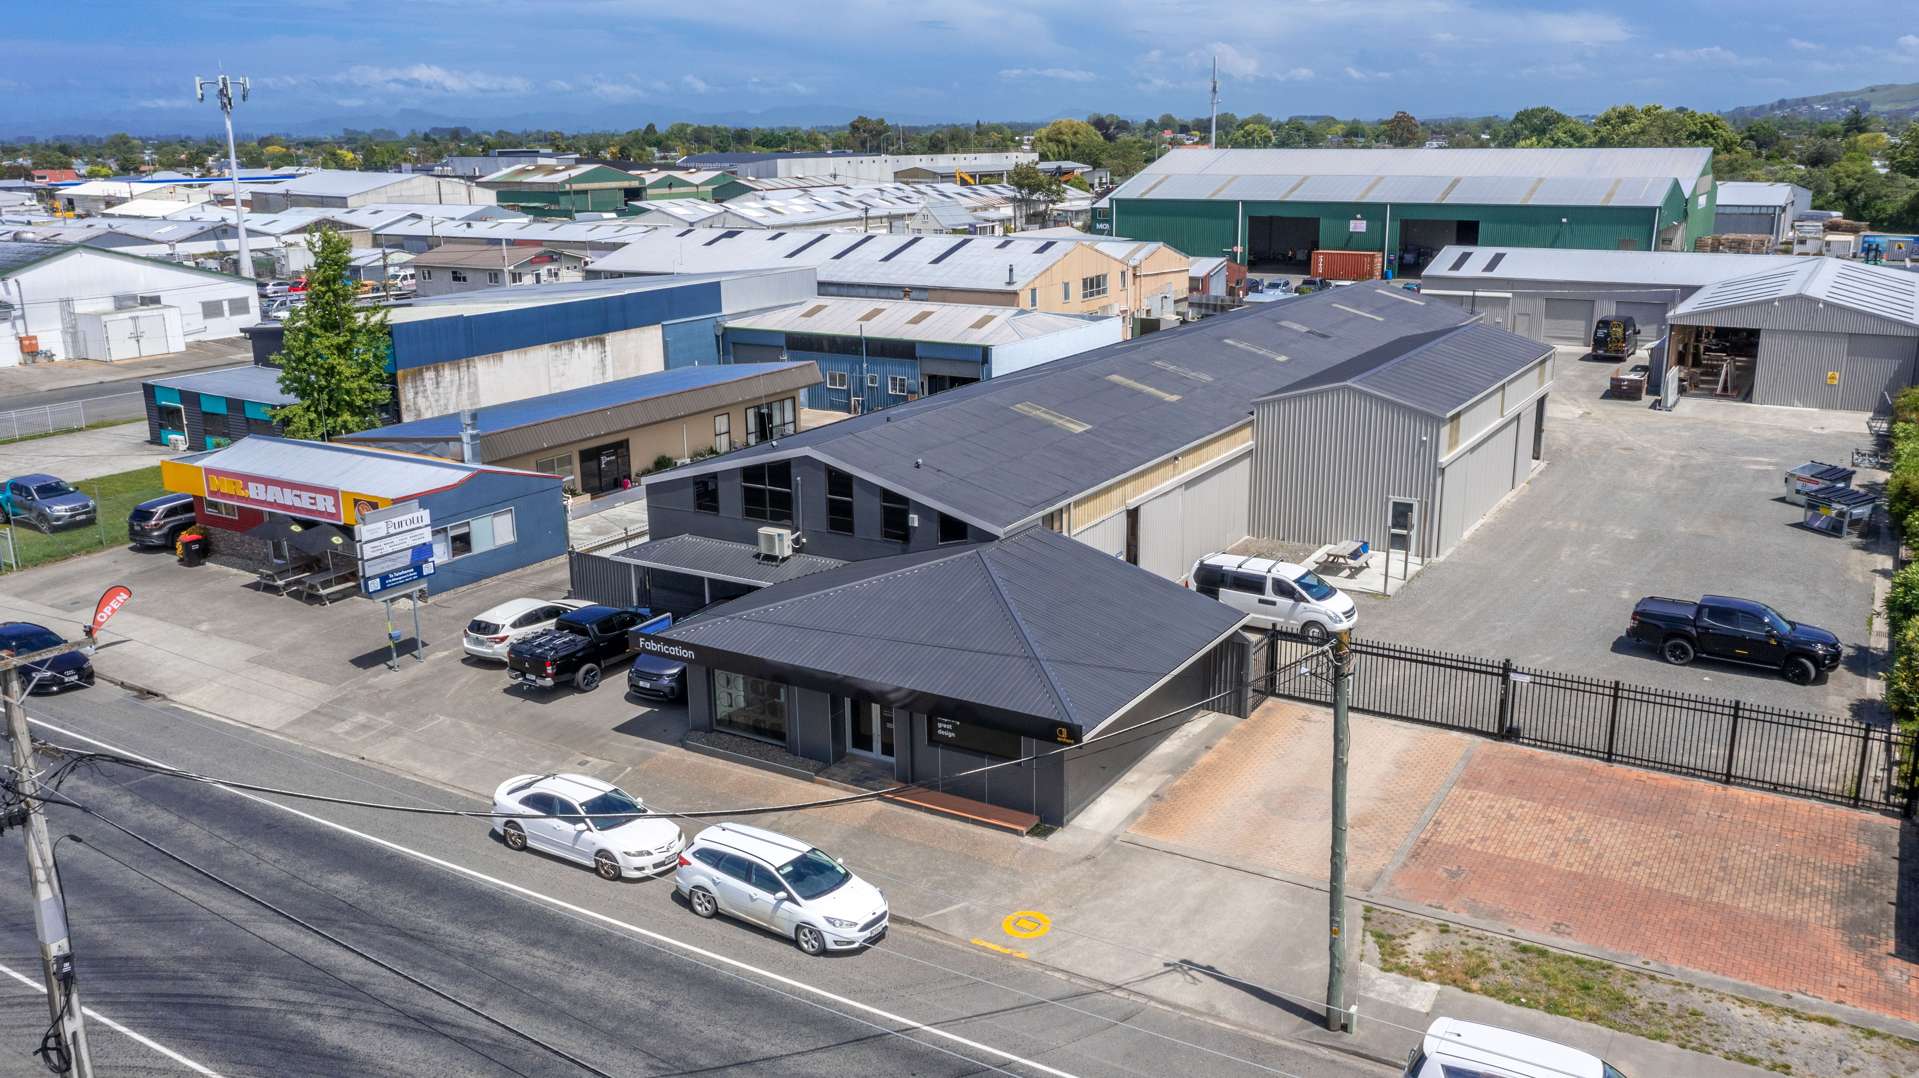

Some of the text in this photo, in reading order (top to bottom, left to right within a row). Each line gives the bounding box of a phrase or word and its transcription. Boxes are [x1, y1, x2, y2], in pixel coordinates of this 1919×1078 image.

[248, 482, 337, 514] BAKER
[97, 592, 130, 622] OPEN
[640, 637, 695, 659] Fabrication
